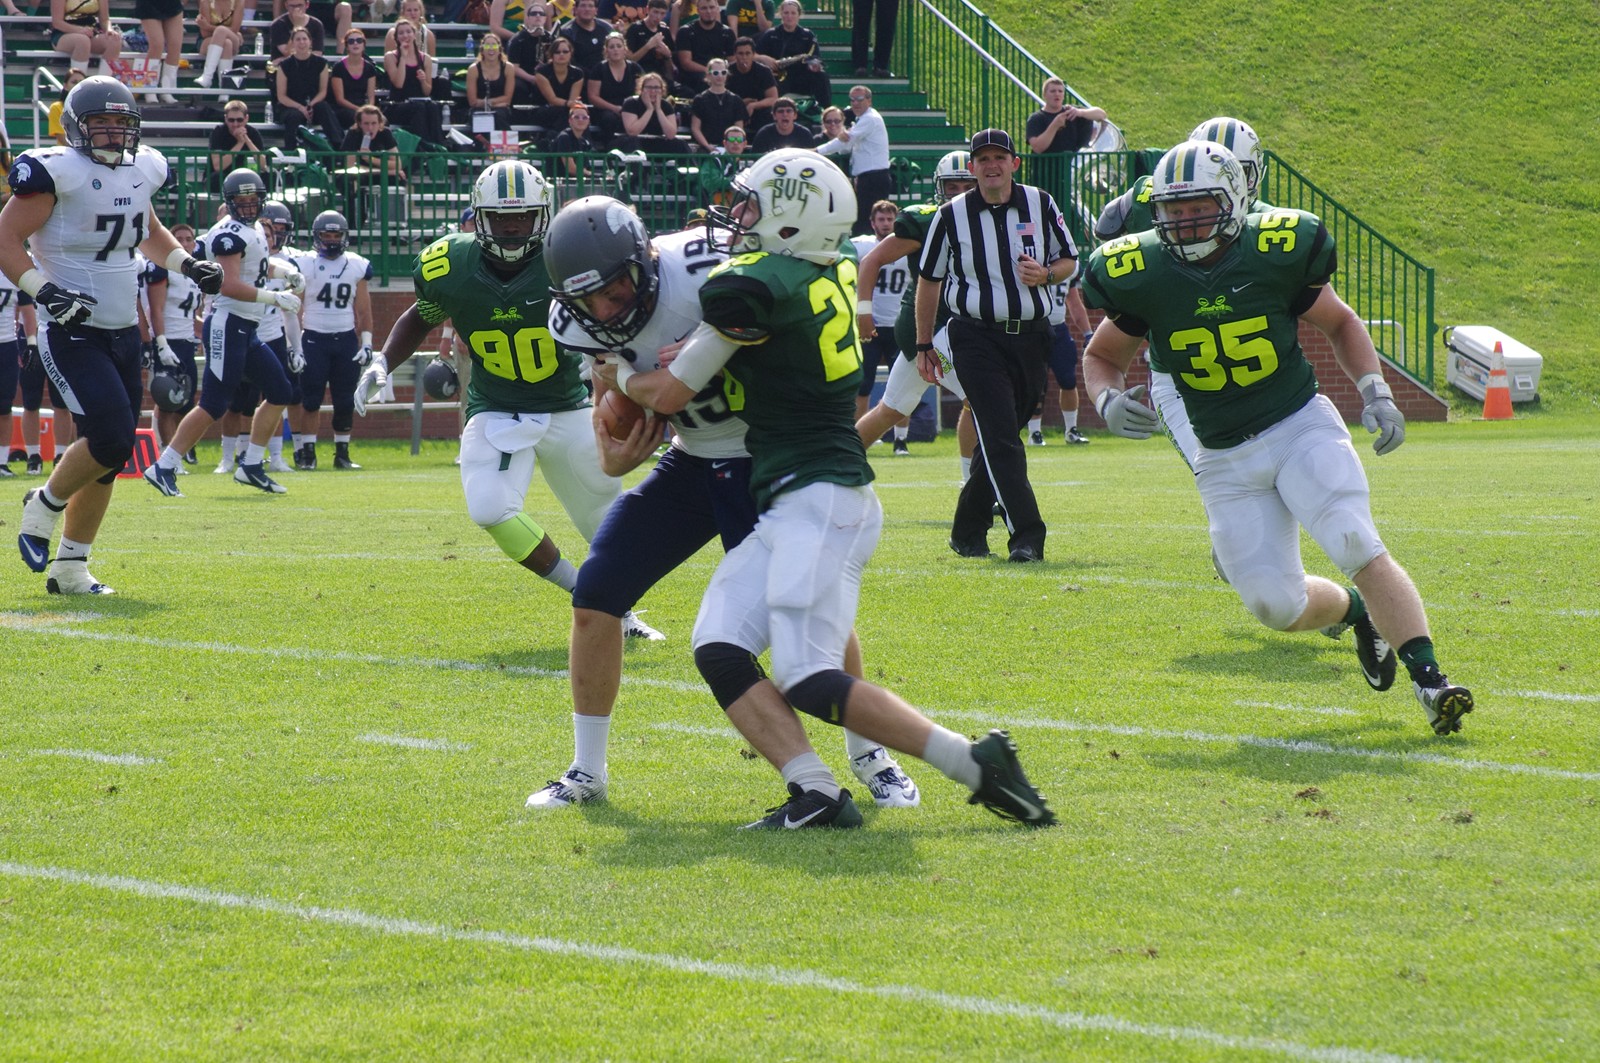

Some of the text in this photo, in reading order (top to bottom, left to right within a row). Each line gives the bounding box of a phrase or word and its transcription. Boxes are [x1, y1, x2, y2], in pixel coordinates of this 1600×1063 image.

[114, 197, 132, 207] CWRU
[772, 178, 809, 212] SVC
[94, 212, 145, 262] 71
[1258, 212, 1300, 253] 35
[420, 240, 451, 282] 90
[1102, 236, 1145, 278] 35
[316, 282, 352, 309] 49
[571, 273, 592, 285] Riddell
[877, 268, 906, 294] 40
[212, 329, 223, 360] SPARTANS
[1169, 315, 1279, 391] 35
[42, 351, 68, 394] SPARTANS
